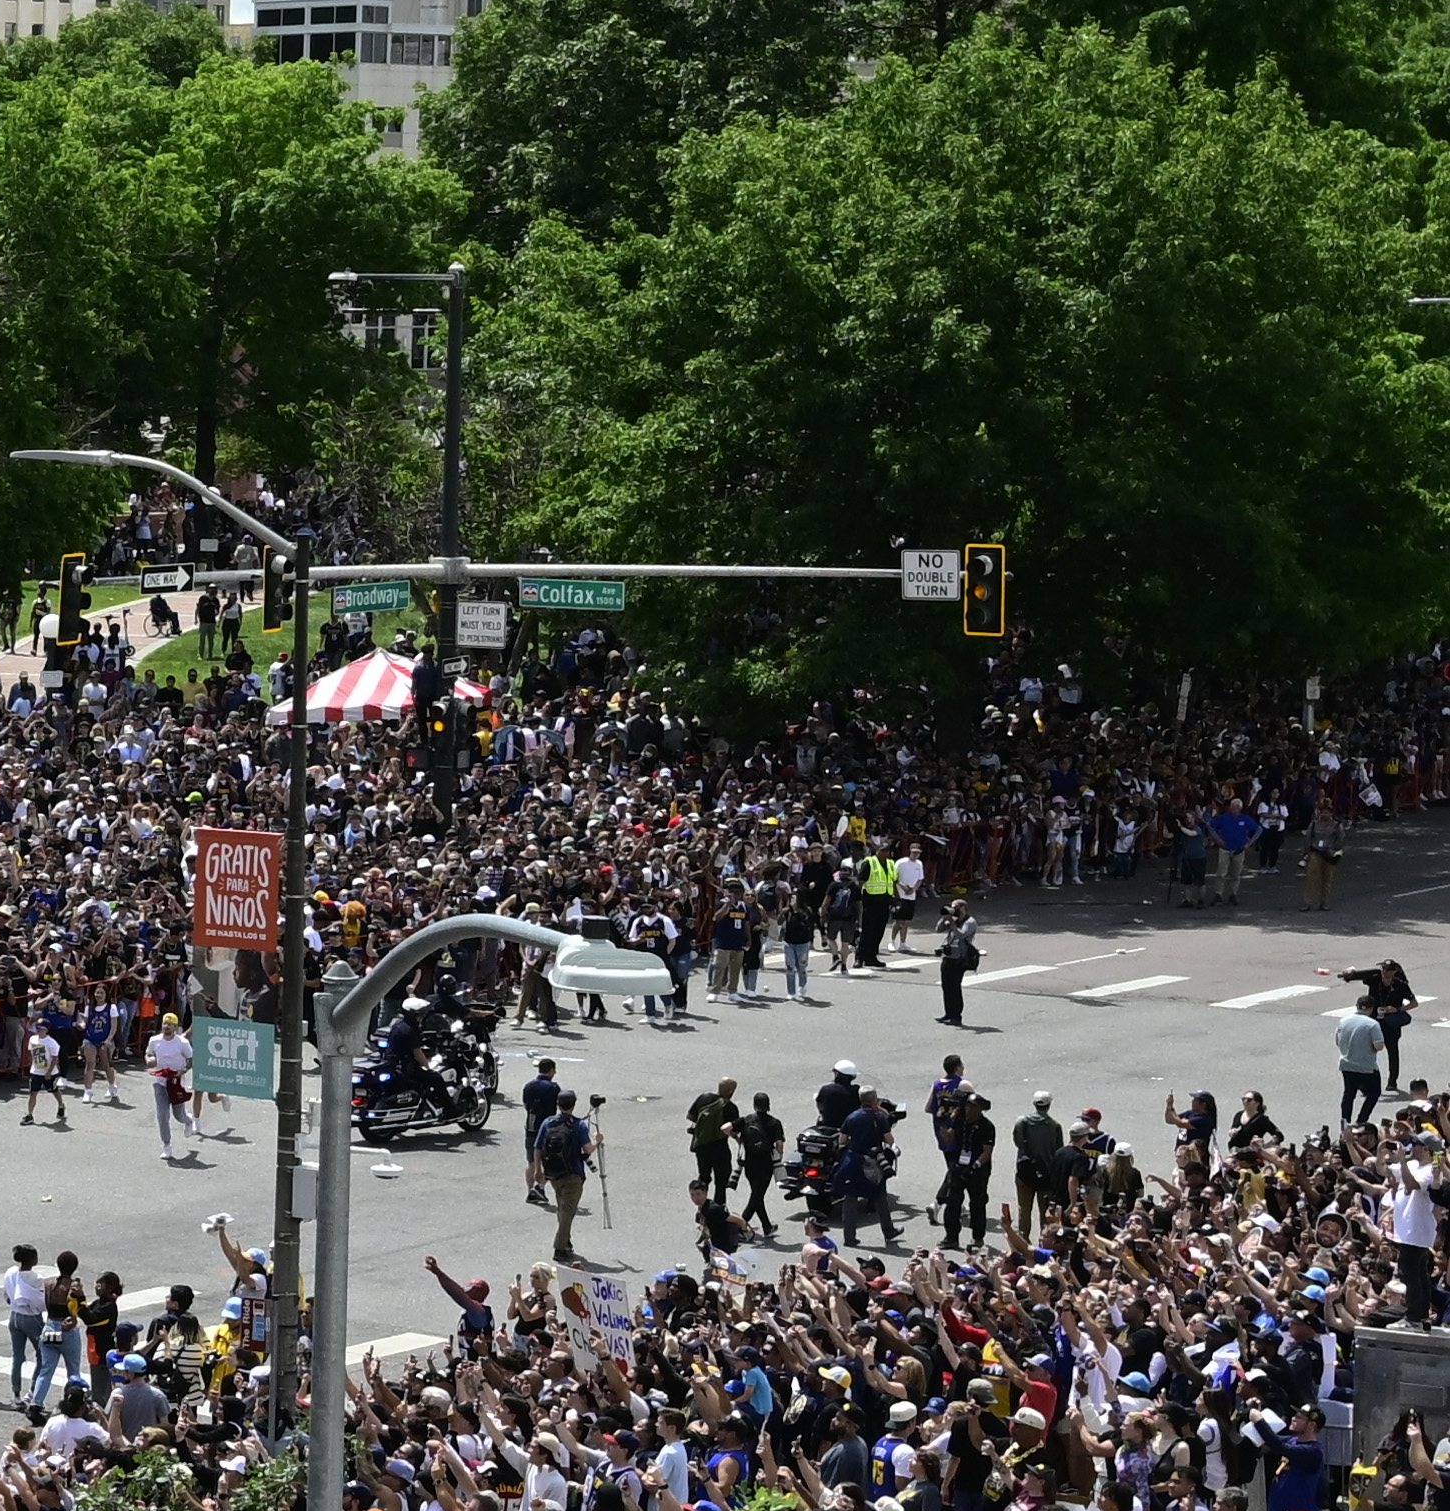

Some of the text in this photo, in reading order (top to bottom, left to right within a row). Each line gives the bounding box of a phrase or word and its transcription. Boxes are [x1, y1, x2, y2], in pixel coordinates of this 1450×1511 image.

[917, 553, 943, 569] NO
[146, 573, 176, 585] ONE WAY
[907, 571, 954, 583] DOUBLE
[539, 585, 616, 605] Colfax Ave
[915, 585, 948, 596] TURN
[346, 588, 399, 607] Broadway
[462, 605, 501, 616] LEFT TURN
[460, 621, 502, 630] MUST YIELD
[465, 634, 503, 643] PEDESTRIANS
[204, 841, 272, 885] GRATIS
[225, 876, 250, 892] PARA
[205, 885, 268, 928] NIÑOS
[217, 930, 240, 938] HASTA
[207, 1026, 256, 1038] DENVER
[207, 1030, 258, 1062] art
[207, 1058, 256, 1071] MUSEUM
[242, 1298, 251, 1348] The Ride
